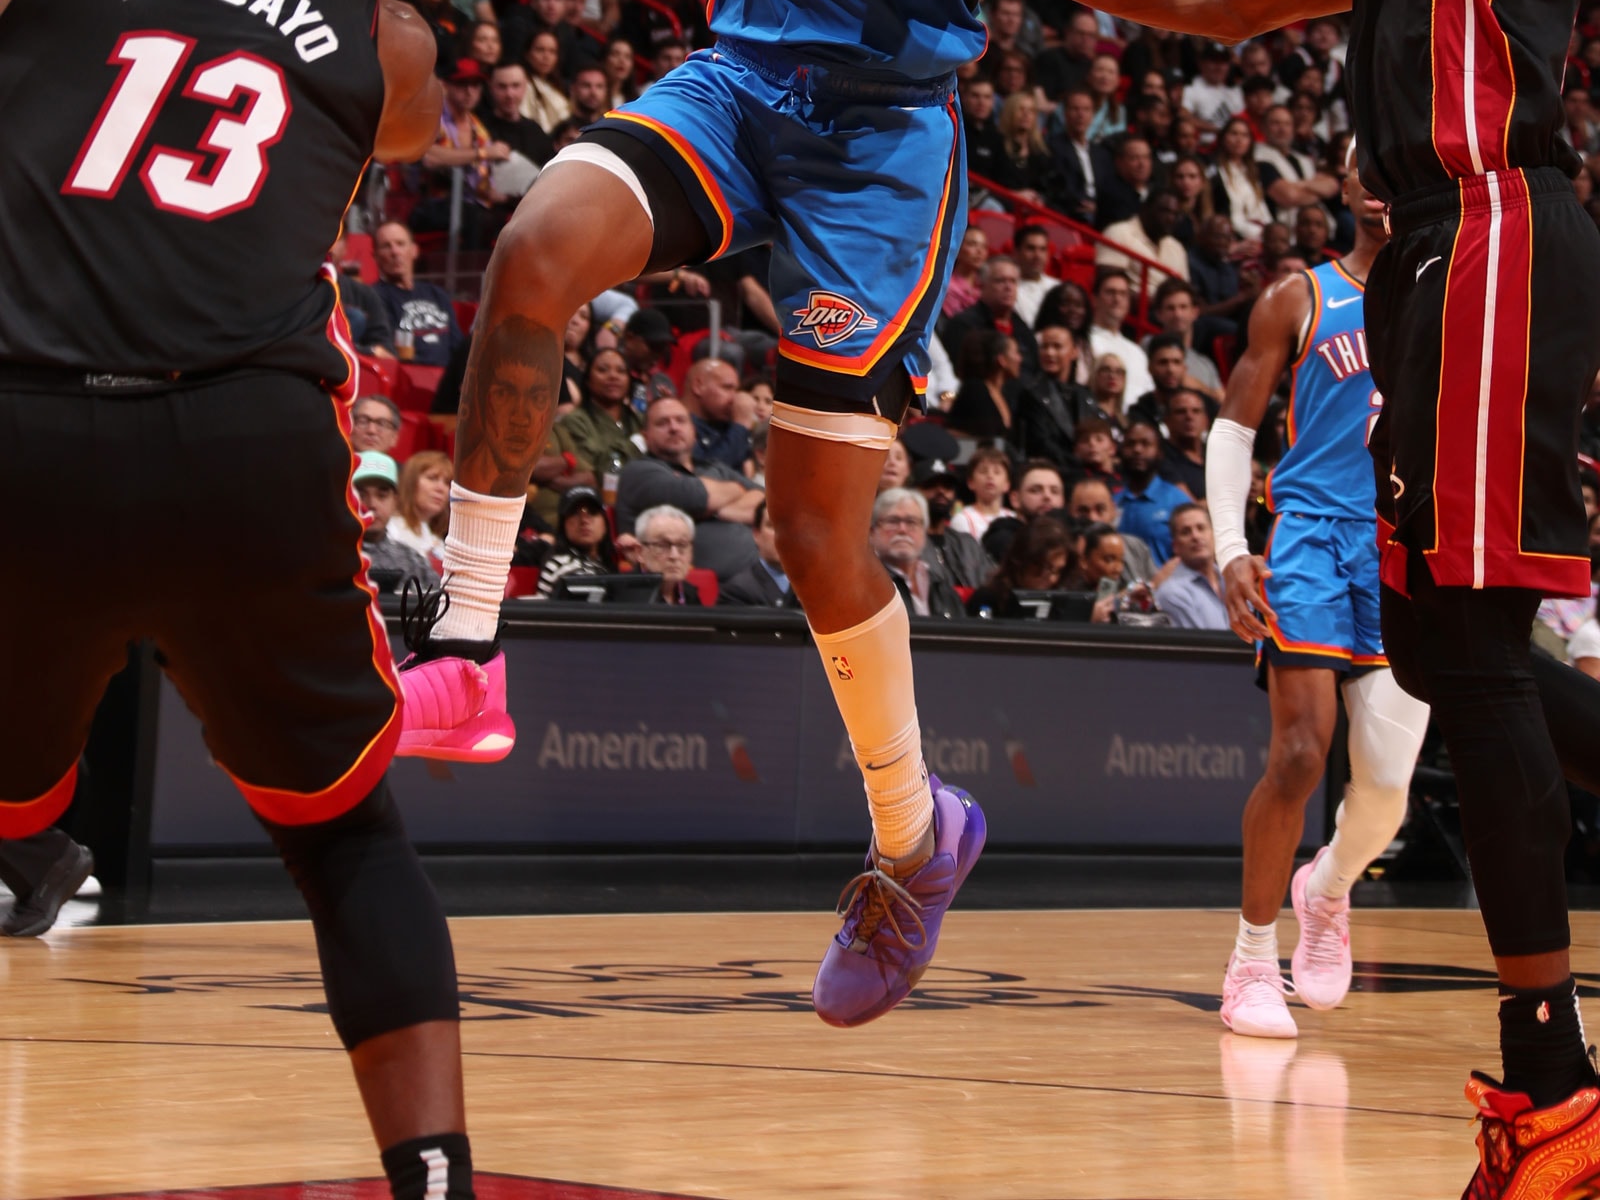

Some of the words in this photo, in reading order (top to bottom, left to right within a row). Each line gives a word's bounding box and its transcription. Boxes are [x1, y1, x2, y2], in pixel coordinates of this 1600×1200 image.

[60, 28, 293, 222] 13
[800, 306, 852, 327] OKC
[537, 721, 708, 771] American
[1105, 733, 1246, 779] American
